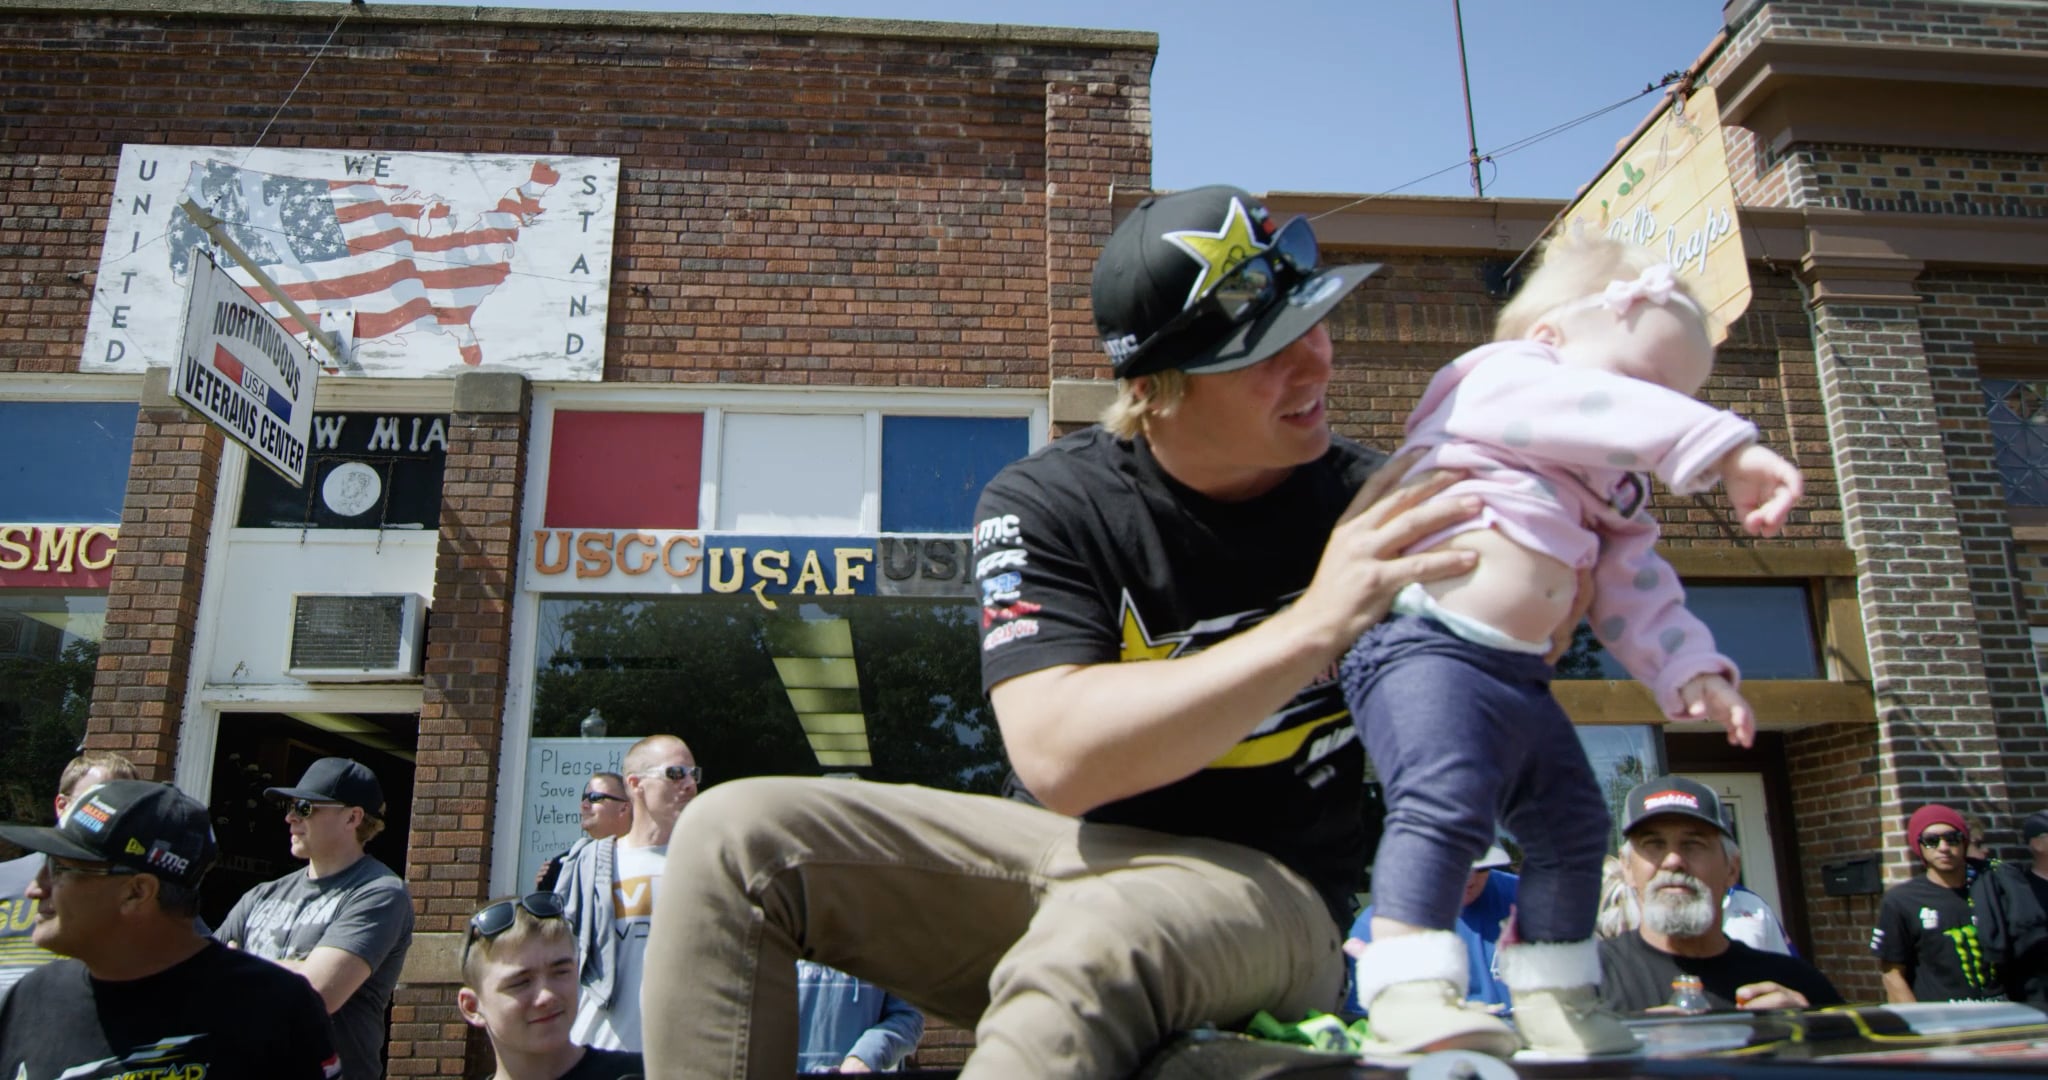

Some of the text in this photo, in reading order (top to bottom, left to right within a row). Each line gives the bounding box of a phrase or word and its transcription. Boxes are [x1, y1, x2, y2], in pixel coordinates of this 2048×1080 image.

[343, 155, 392, 178] WE
[104, 159, 158, 363] UNITED
[565, 174, 598, 356] STAND
[213, 300, 302, 403] NORTHWOODS
[243, 370, 266, 399] USA
[184, 354, 304, 476] VETERANS CENTER
[367, 415, 448, 452] MIA
[707, 546, 874, 610] USAF
[540, 748, 626, 776] Please H
[539, 781, 576, 798] Save
